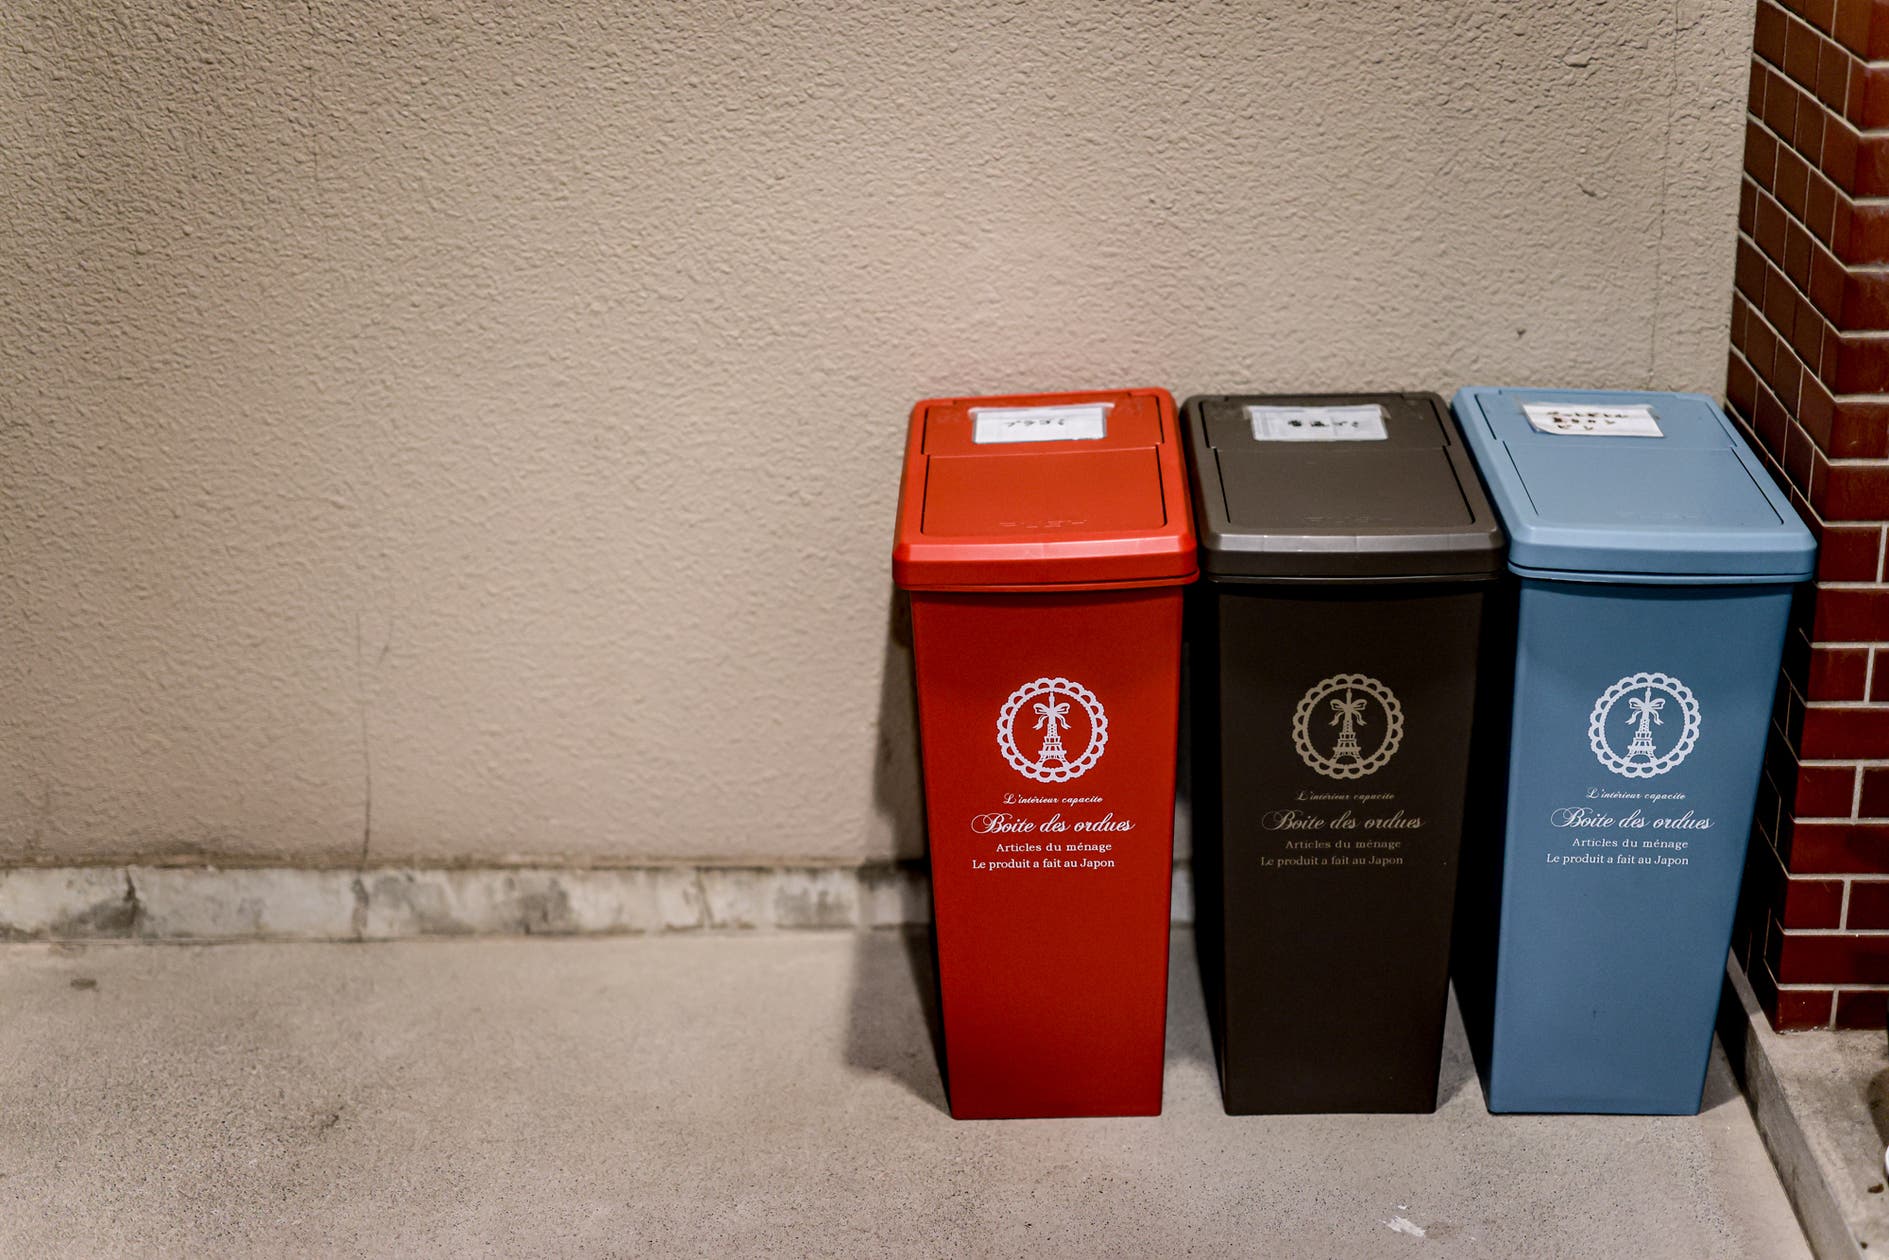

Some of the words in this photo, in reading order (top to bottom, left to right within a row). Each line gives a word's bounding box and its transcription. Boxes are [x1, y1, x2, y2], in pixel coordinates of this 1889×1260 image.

[971, 813, 1036, 833] Boite
[1040, 813, 1071, 833] des
[1074, 813, 1135, 832] ordues
[1262, 810, 1327, 831] Boite
[1330, 810, 1361, 830] des
[1364, 810, 1427, 830] ordues
[1551, 807, 1615, 827] Boite
[1619, 809, 1650, 828] des
[1653, 810, 1714, 829] ordues
[996, 843, 1041, 852] Articles
[1046, 843, 1061, 851] du
[1067, 843, 1111, 853] ménage
[1286, 840, 1332, 849] Articles
[1335, 840, 1351, 849] du
[1356, 840, 1401, 850] ménage
[1573, 838, 1617, 847] Articles
[1623, 839, 1637, 847] du
[1643, 840, 1688, 850] ménage
[973, 860, 986, 868] Le
[989, 859, 1030, 871] produit
[1043, 858, 1061, 867] fait
[1080, 859, 1114, 869] Japon
[1261, 857, 1275, 866] Le
[1278, 856, 1318, 868] produit
[1332, 856, 1349, 865] fait
[1369, 856, 1404, 867] Japon
[1547, 854, 1559, 862] Le
[1563, 854, 1603, 865] produit
[1617, 854, 1635, 864] fait
[1654, 856, 1688, 867] Japon
